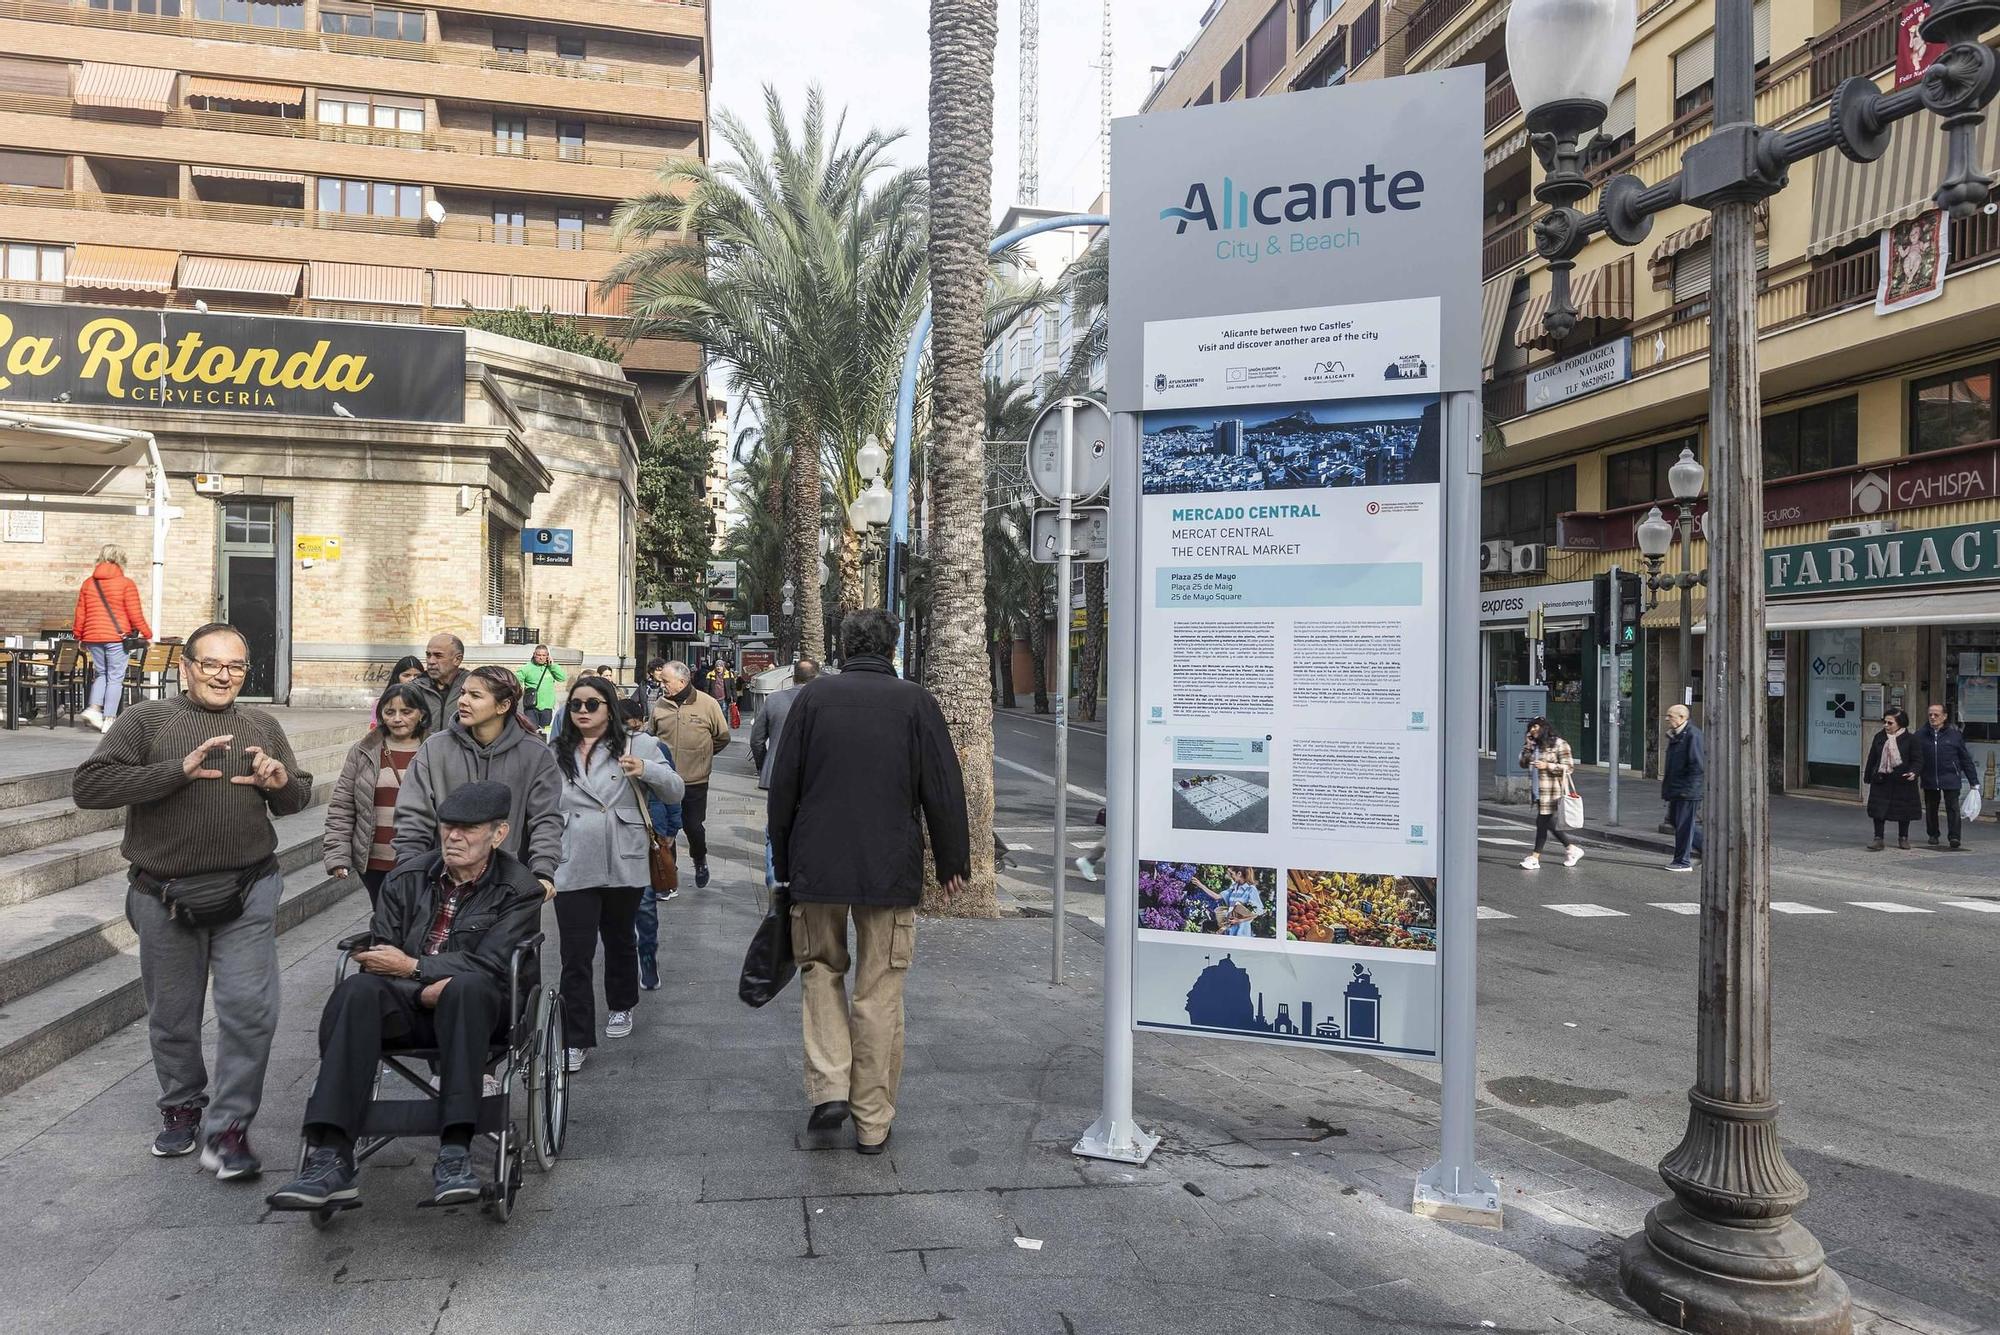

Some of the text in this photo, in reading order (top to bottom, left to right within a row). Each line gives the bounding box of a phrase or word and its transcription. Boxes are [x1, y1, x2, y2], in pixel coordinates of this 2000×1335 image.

[1160, 164, 1425, 234] Alicante
[1216, 228, 1360, 263] City & Beach
[1261, 326, 1297, 336] between
[1300, 324, 1317, 332] two
[1198, 331, 1379, 352] Visit and discover another area of the city
[77, 317, 375, 399] Rotonda
[1534, 346, 1615, 383] CLINICA PODOLOGICA
[1580, 358, 1615, 378] NAVARRO
[132, 387, 276, 406] CERVECERÍA
[1566, 383, 1580, 395] TLF
[1898, 470, 1985, 505] CAHISPA
[1172, 504, 1321, 522] MERCADO CENTRAL
[1763, 507, 1800, 524] EGUROS
[1172, 527, 1274, 540] MERCAT CENTRAL
[540, 533, 570, 554] B S
[1172, 544, 1301, 557] THE CENTRAL MARKET
[1216, 573, 1237, 582] Mayo
[1171, 583, 1191, 592] Plaça
[1214, 582, 1233, 592] Maig
[1193, 593, 1214, 602] Mayo
[1216, 593, 1242, 601] Square
[1481, 597, 1524, 615] express
[1561, 600, 1583, 608] domingos
[1815, 720, 1845, 728] Eduardo
[1823, 728, 1858, 736] Farmacia
